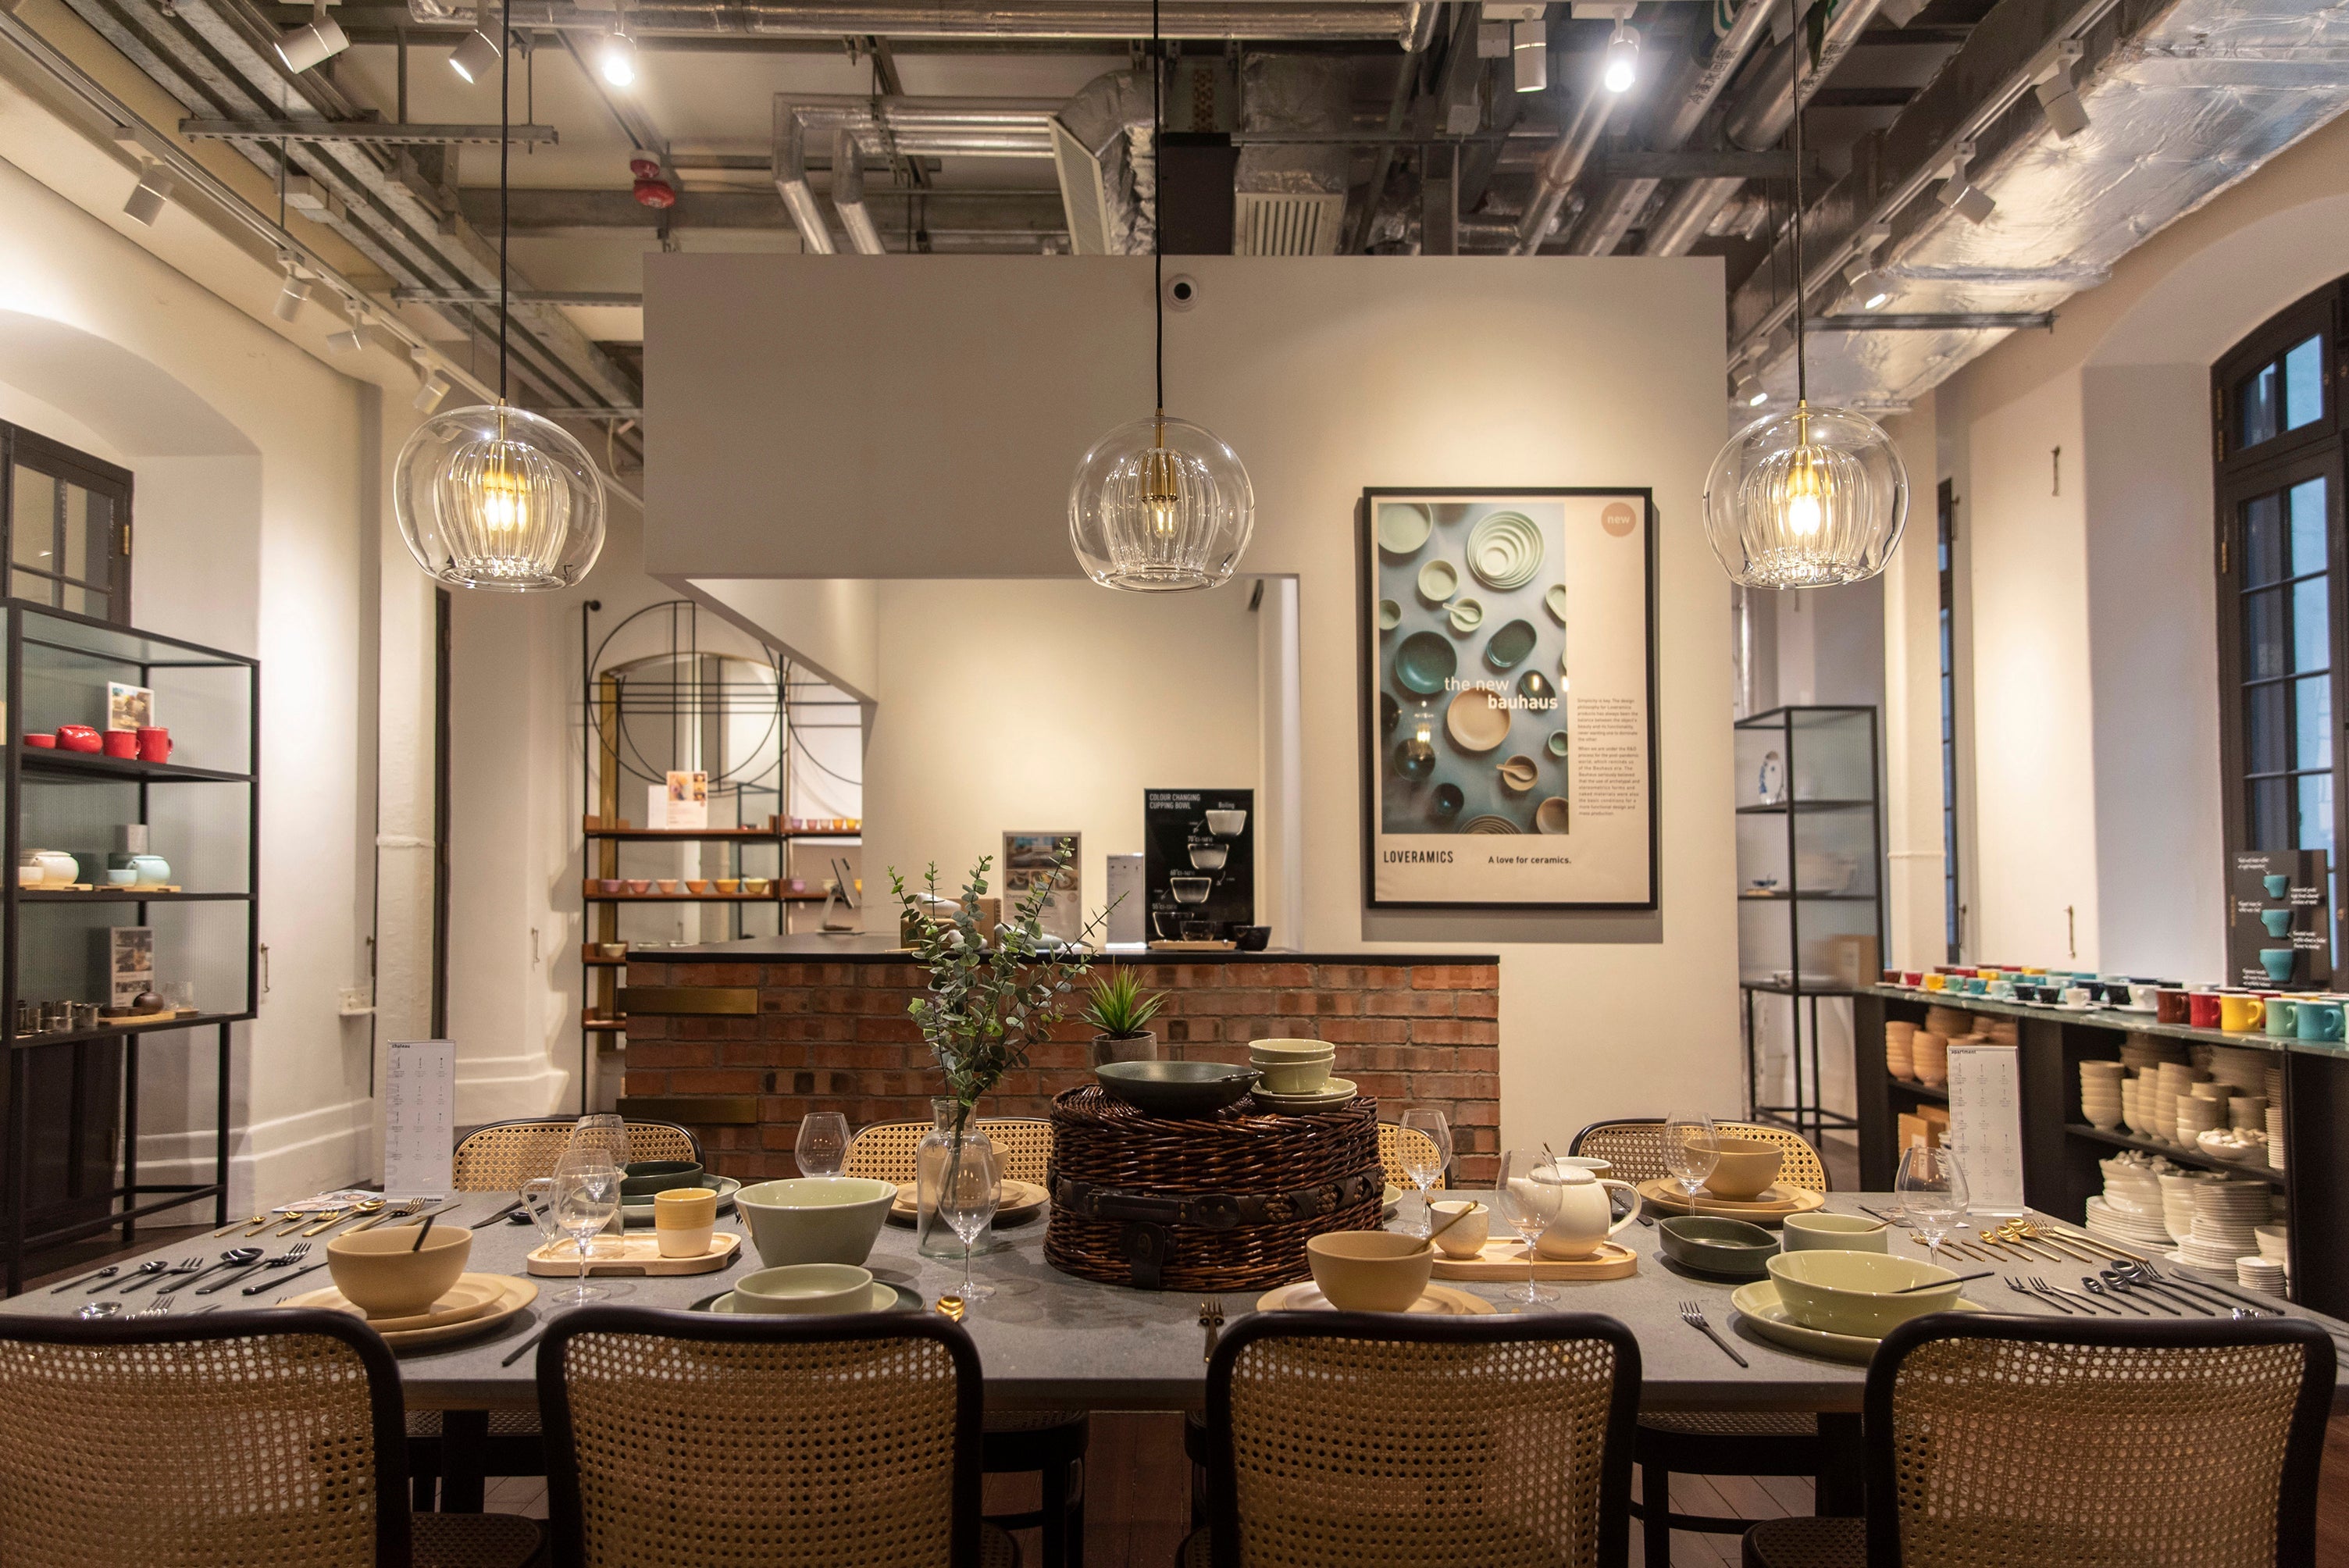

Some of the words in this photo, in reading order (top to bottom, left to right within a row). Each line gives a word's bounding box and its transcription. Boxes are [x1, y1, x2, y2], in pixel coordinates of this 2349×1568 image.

[1607, 515, 1631, 524] new
[1444, 675, 1470, 691] the
[1476, 679, 1510, 691] new
[1488, 693, 1559, 710] bauhaus
[1384, 850, 1453, 864] LOVERAMICS
